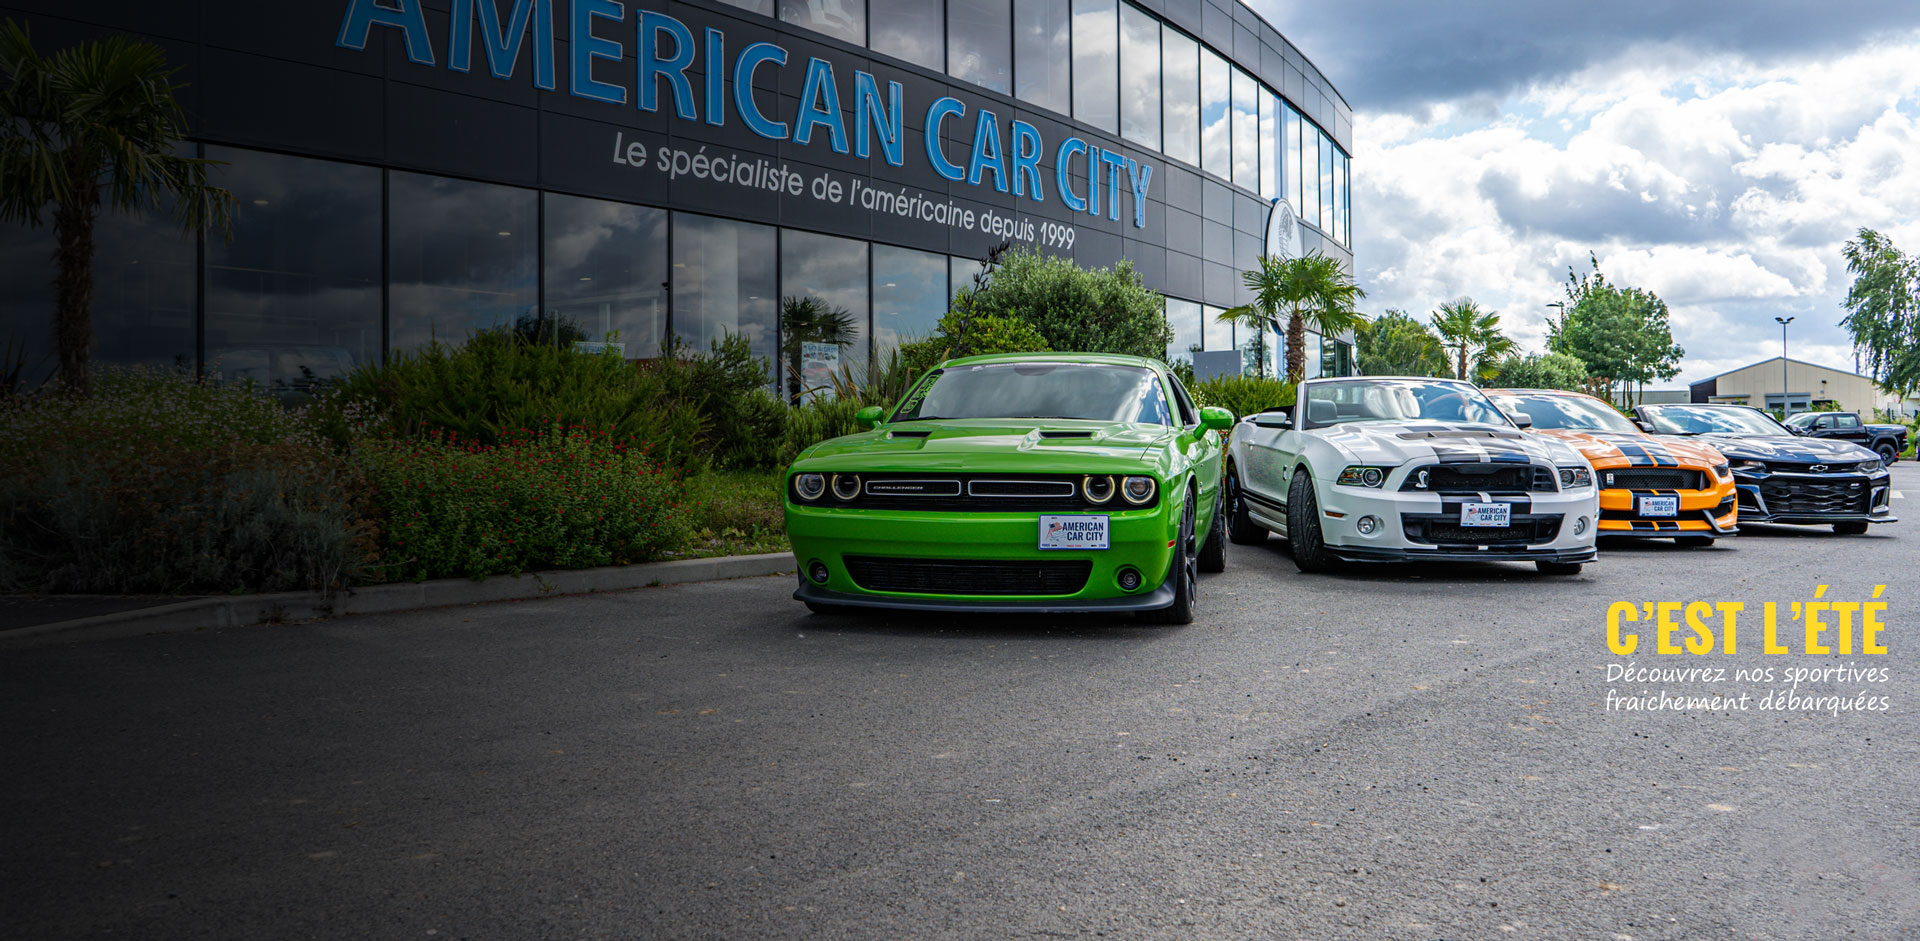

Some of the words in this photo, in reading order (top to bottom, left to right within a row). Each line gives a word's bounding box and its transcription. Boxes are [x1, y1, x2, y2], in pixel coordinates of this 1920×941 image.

[335, 0, 903, 166] AMERICAN
[924, 97, 1043, 202] CAR
[1056, 138, 1152, 230] CITY
[612, 131, 648, 168] Le
[656, 145, 804, 196] spécialiste
[811, 173, 843, 204] de
[980, 209, 1035, 242] depuis
[1040, 221, 1075, 250] 1999
[1478, 507, 1508, 515] AMERICAN
[1062, 521, 1104, 531] AMERICAN
[1066, 531, 1083, 541] CAR
[1086, 531, 1104, 541] CITY
